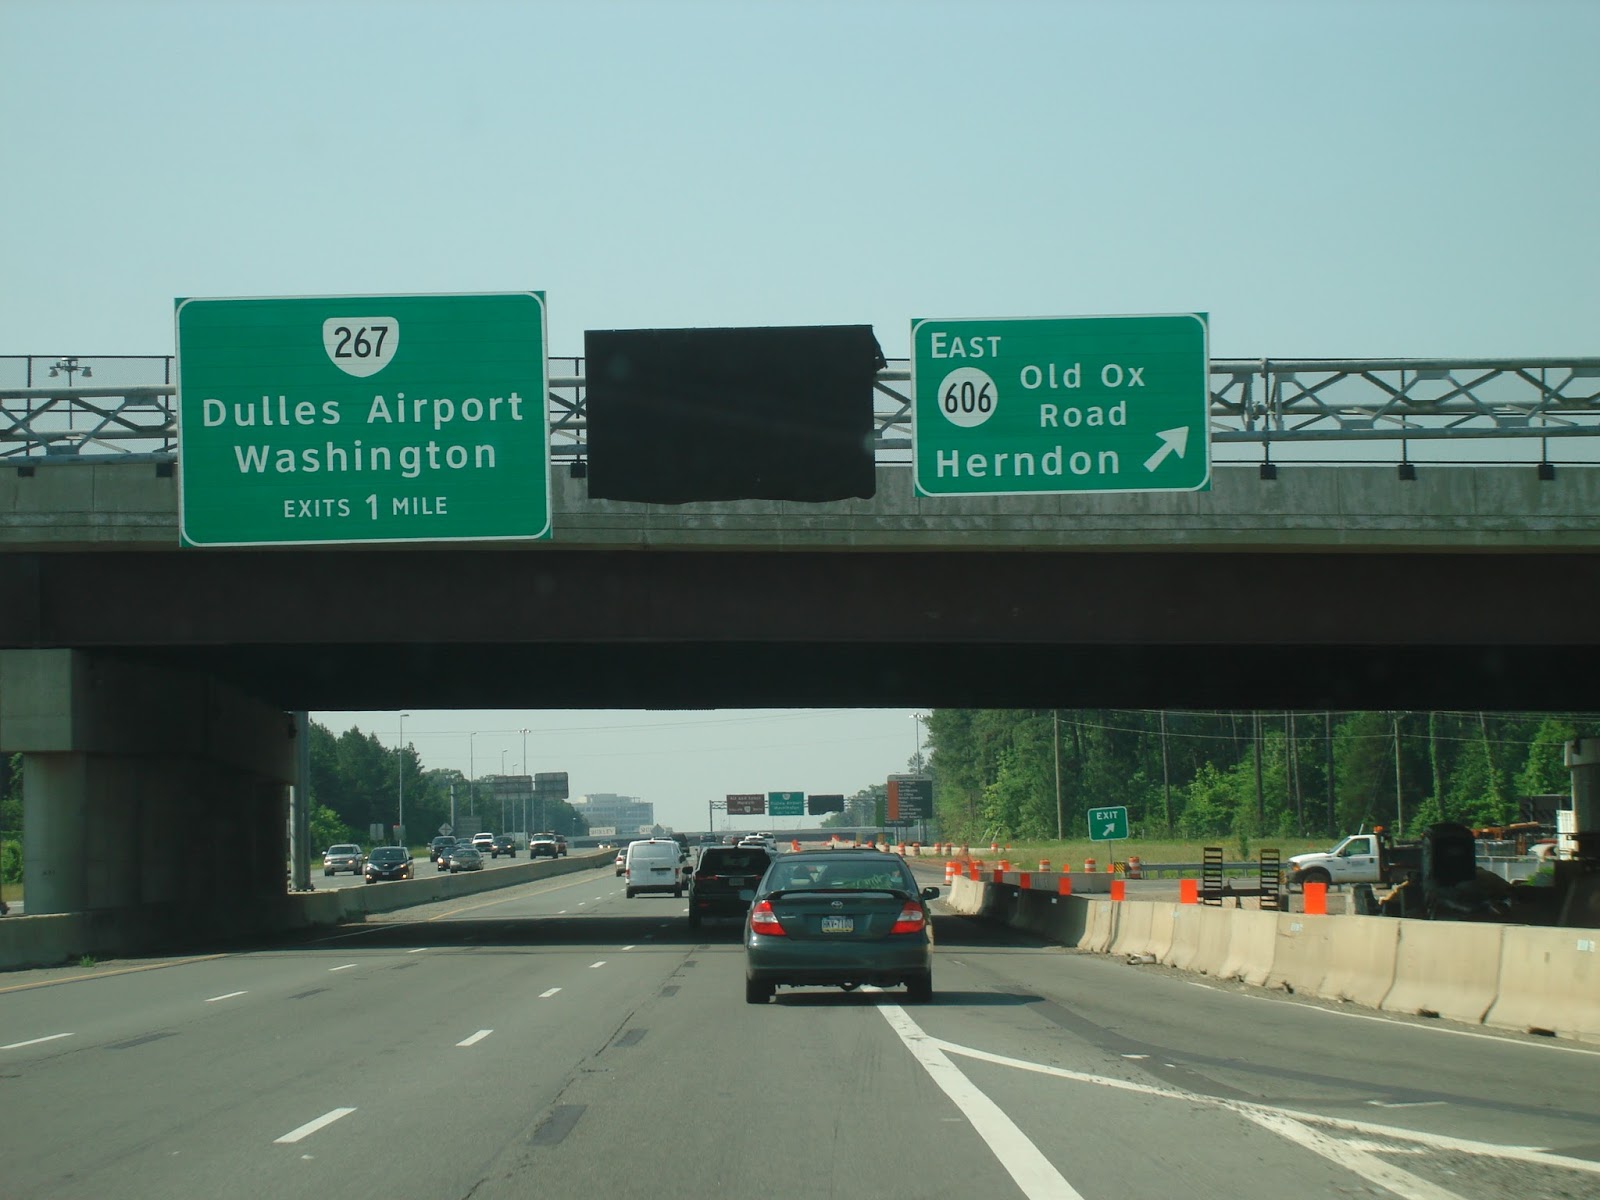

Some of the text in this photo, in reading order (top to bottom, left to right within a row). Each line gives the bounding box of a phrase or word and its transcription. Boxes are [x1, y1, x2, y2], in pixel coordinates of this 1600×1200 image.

[334, 326, 388, 358] 267
[931, 332, 1001, 359] EAST
[1020, 363, 1146, 390] Old Ox
[203, 392, 523, 431] Dulles Airport
[944, 381, 991, 414] 606
[1040, 400, 1127, 428] Road
[234, 440, 496, 478] Washington
[936, 445, 1120, 478] Herndon
[284, 493, 448, 520] EXITS 1 MILE
[1096, 811, 1118, 820] EXIT
